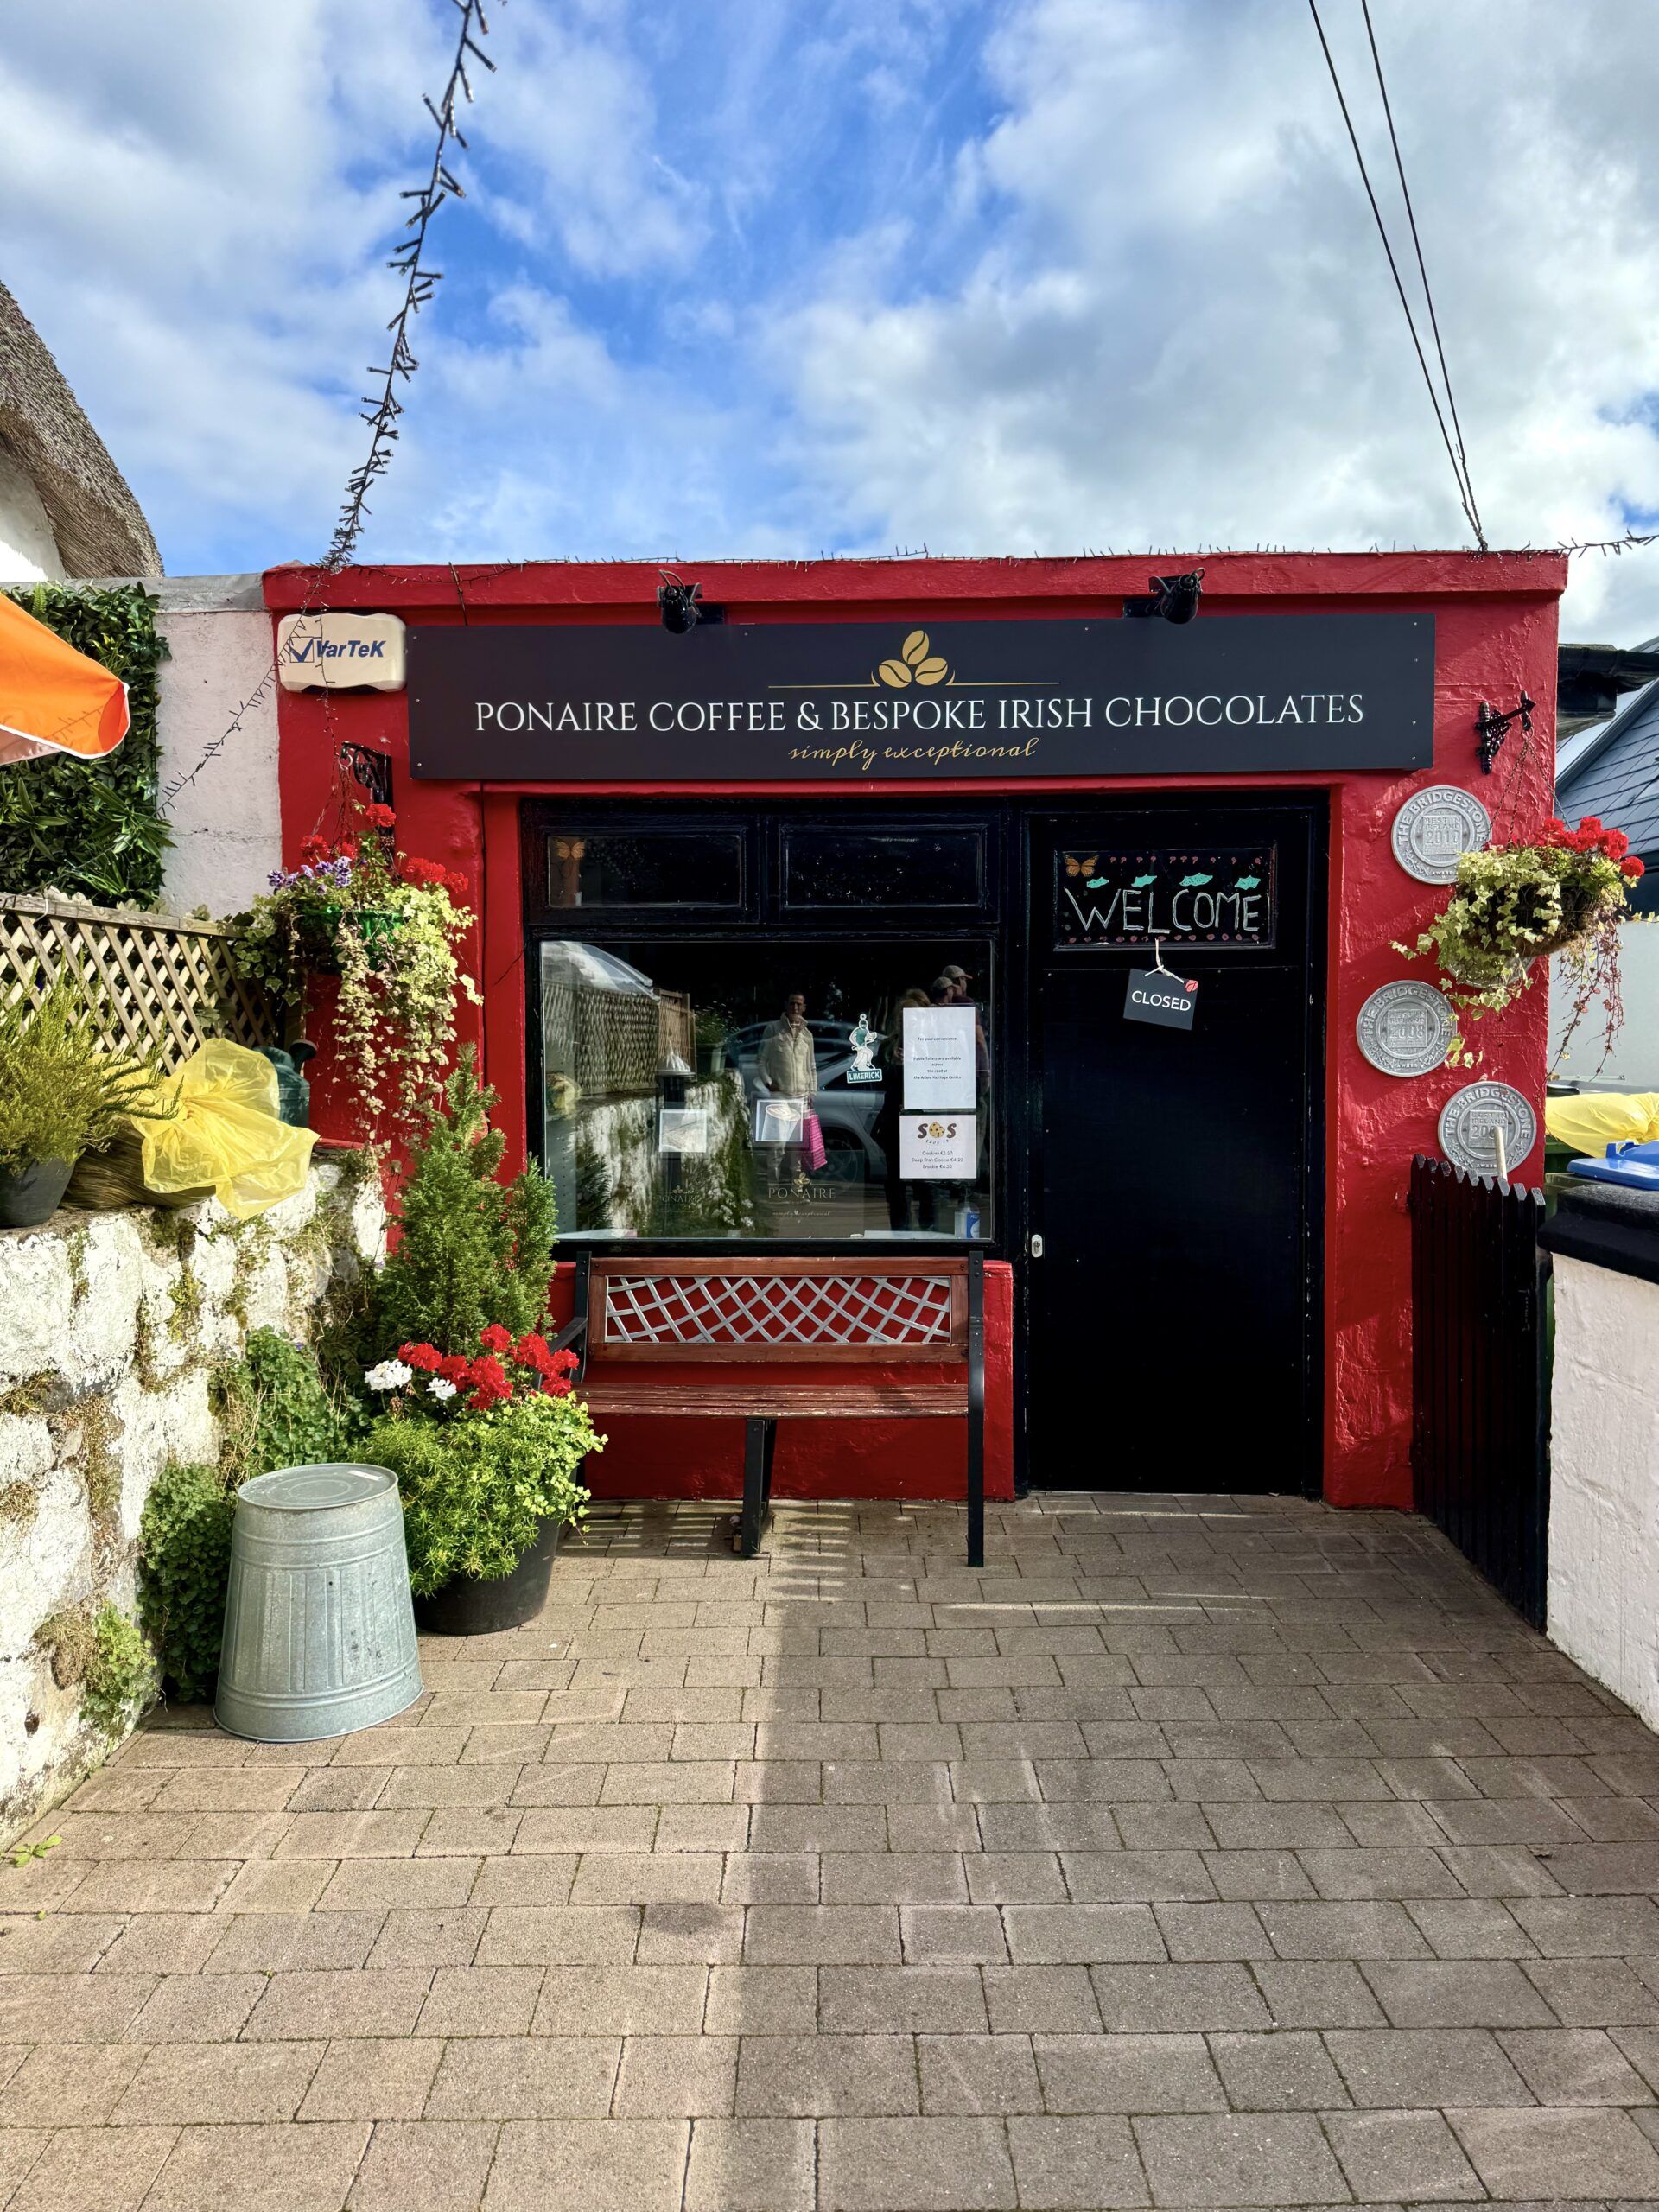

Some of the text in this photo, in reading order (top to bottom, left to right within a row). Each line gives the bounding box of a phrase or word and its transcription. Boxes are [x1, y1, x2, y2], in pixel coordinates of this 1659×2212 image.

[316, 640, 386, 658] VarTeK
[475, 694, 1364, 733] PONAIRE COFFEE & BESPOKE IRISH CHOCOLATES
[788, 737, 1039, 771] simply exceptional
[1398, 791, 1486, 845] THE BRIDGESTONE
[1064, 887, 1261, 934] WELCOME
[1131, 990, 1192, 1012] CLOSED
[1363, 986, 1452, 1038] THE BRIDGESTONE
[849, 1071, 880, 1081] LIMERICK
[1445, 1108, 1460, 1138] THE
[768, 1187, 836, 1199] PONAIRE
